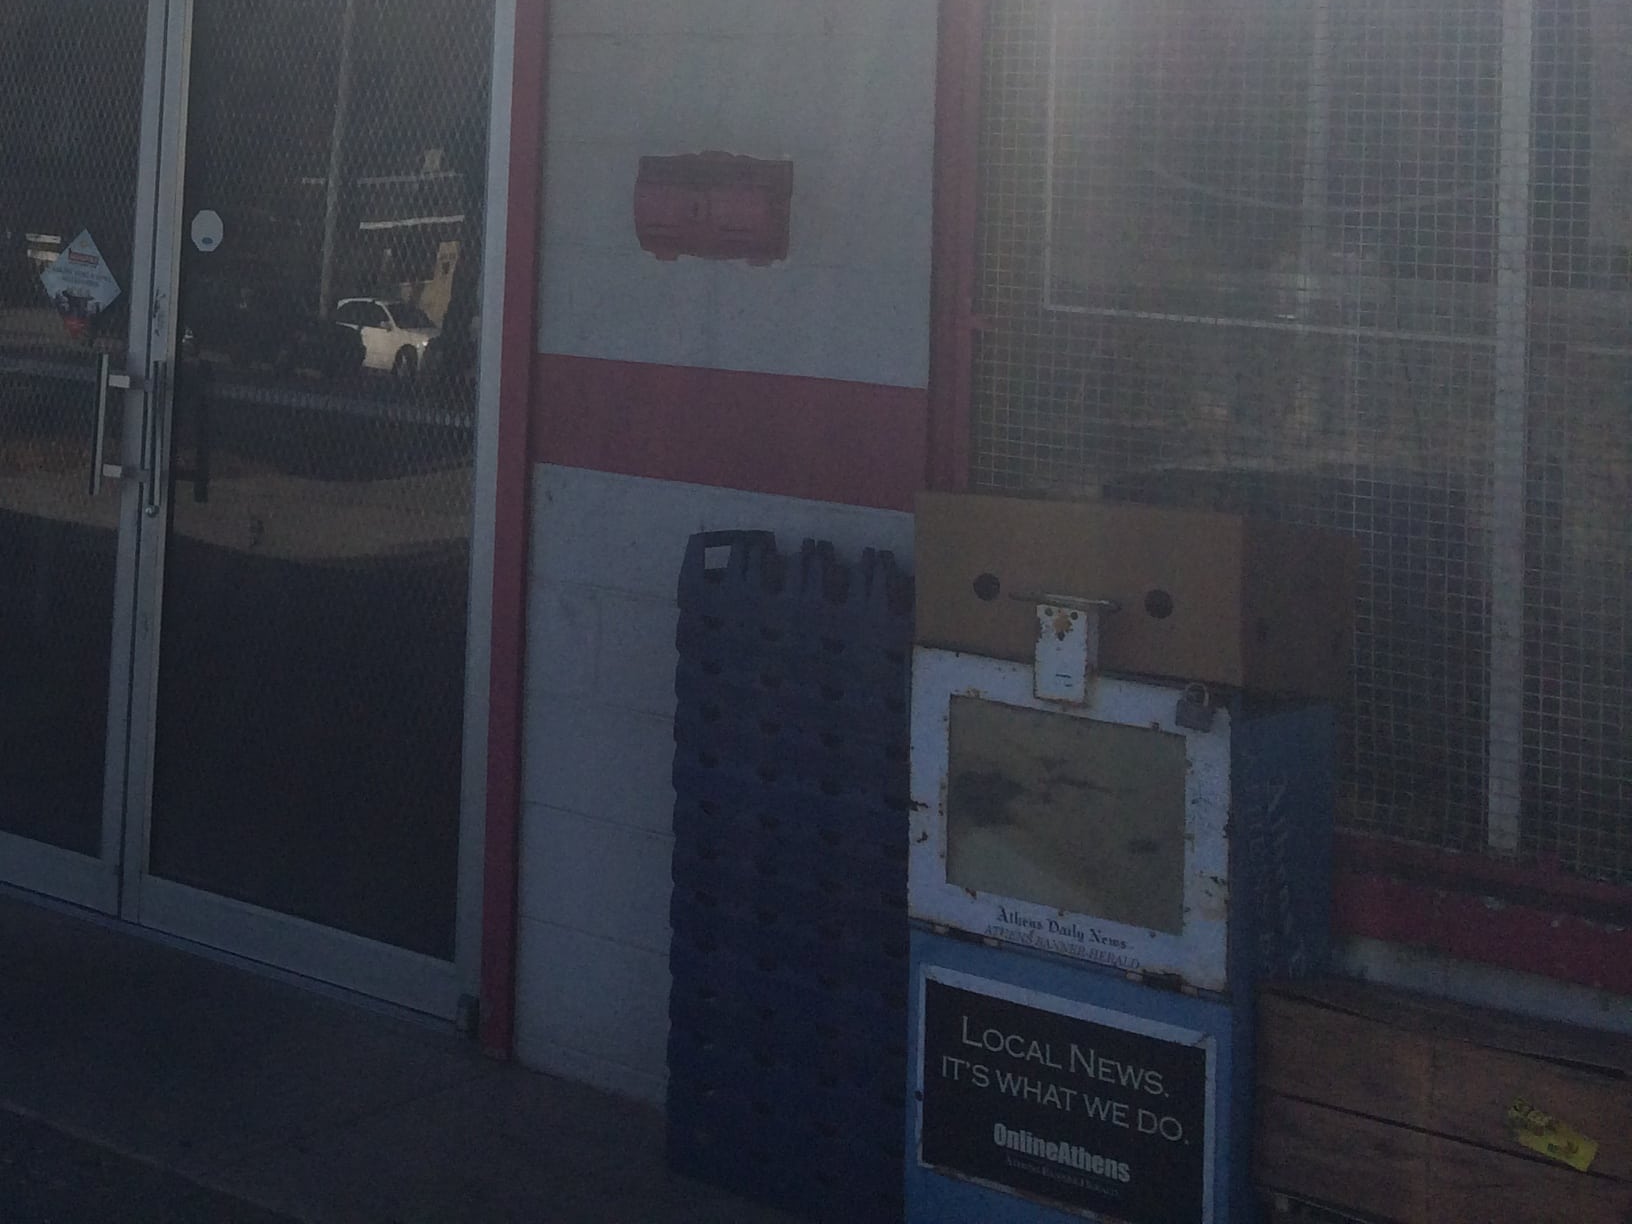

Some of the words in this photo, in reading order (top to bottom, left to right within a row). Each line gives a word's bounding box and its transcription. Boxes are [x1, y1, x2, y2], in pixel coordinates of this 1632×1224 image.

[997, 907, 1043, 930] Athens
[1046, 918, 1085, 942] Daily
[941, 1055, 990, 1088] IT'S
[996, 1069, 1077, 1112] WHAT
[1083, 1094, 1130, 1129] WE
[1137, 1108, 1190, 1146] DO.
[993, 1122, 1132, 1184] OnlineAthens
